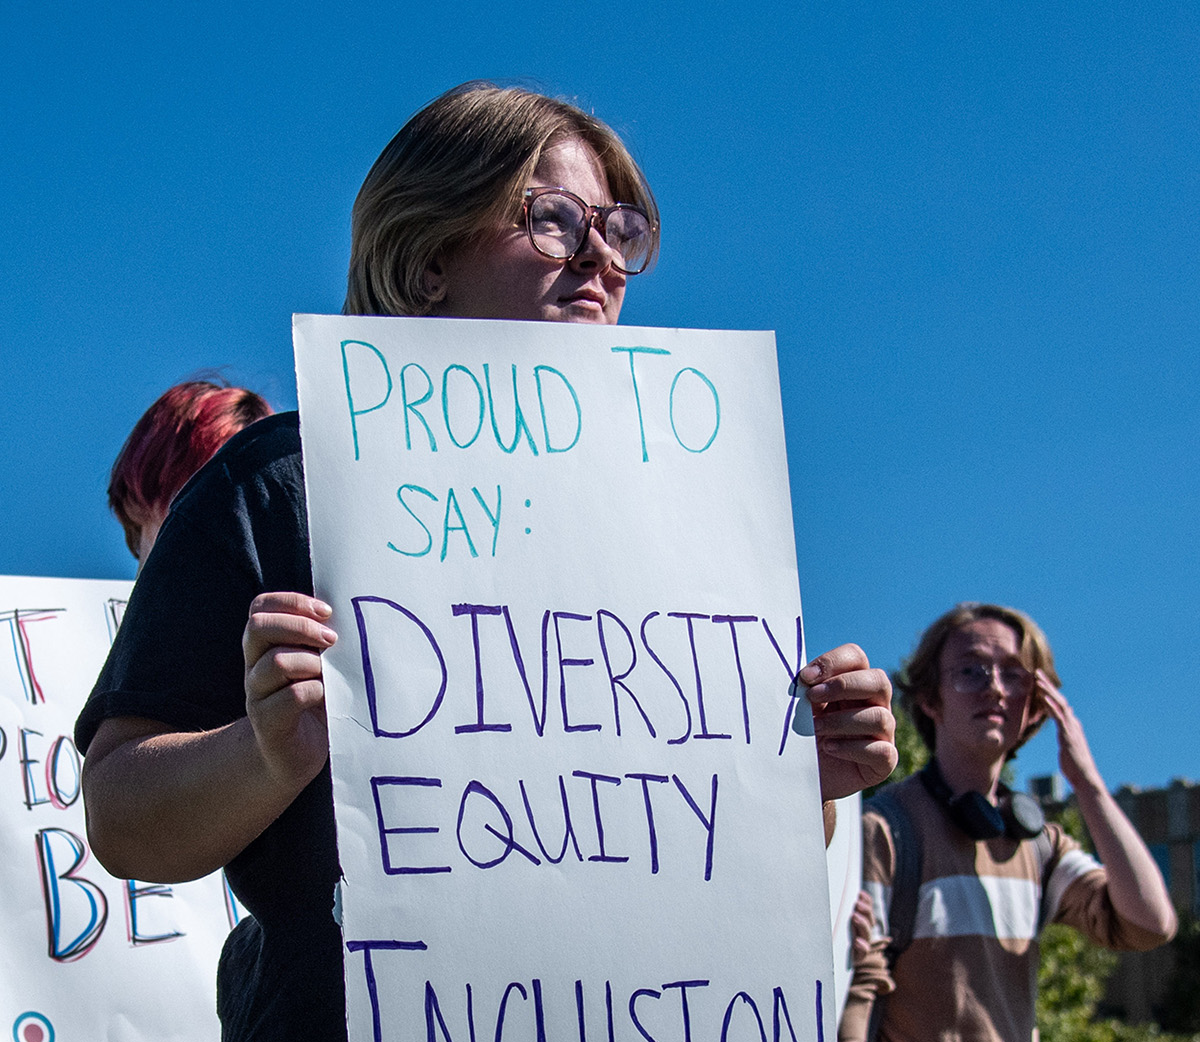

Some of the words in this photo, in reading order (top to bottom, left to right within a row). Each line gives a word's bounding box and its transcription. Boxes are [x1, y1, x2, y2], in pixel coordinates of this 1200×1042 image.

[340, 339, 583, 461] PROUD
[610, 345, 721, 463] TO
[386, 482, 533, 563] SAY:
[351, 595, 804, 756] DIVERSITY
[370, 769, 719, 882] EQUITY
[34, 826, 238, 963] BE
